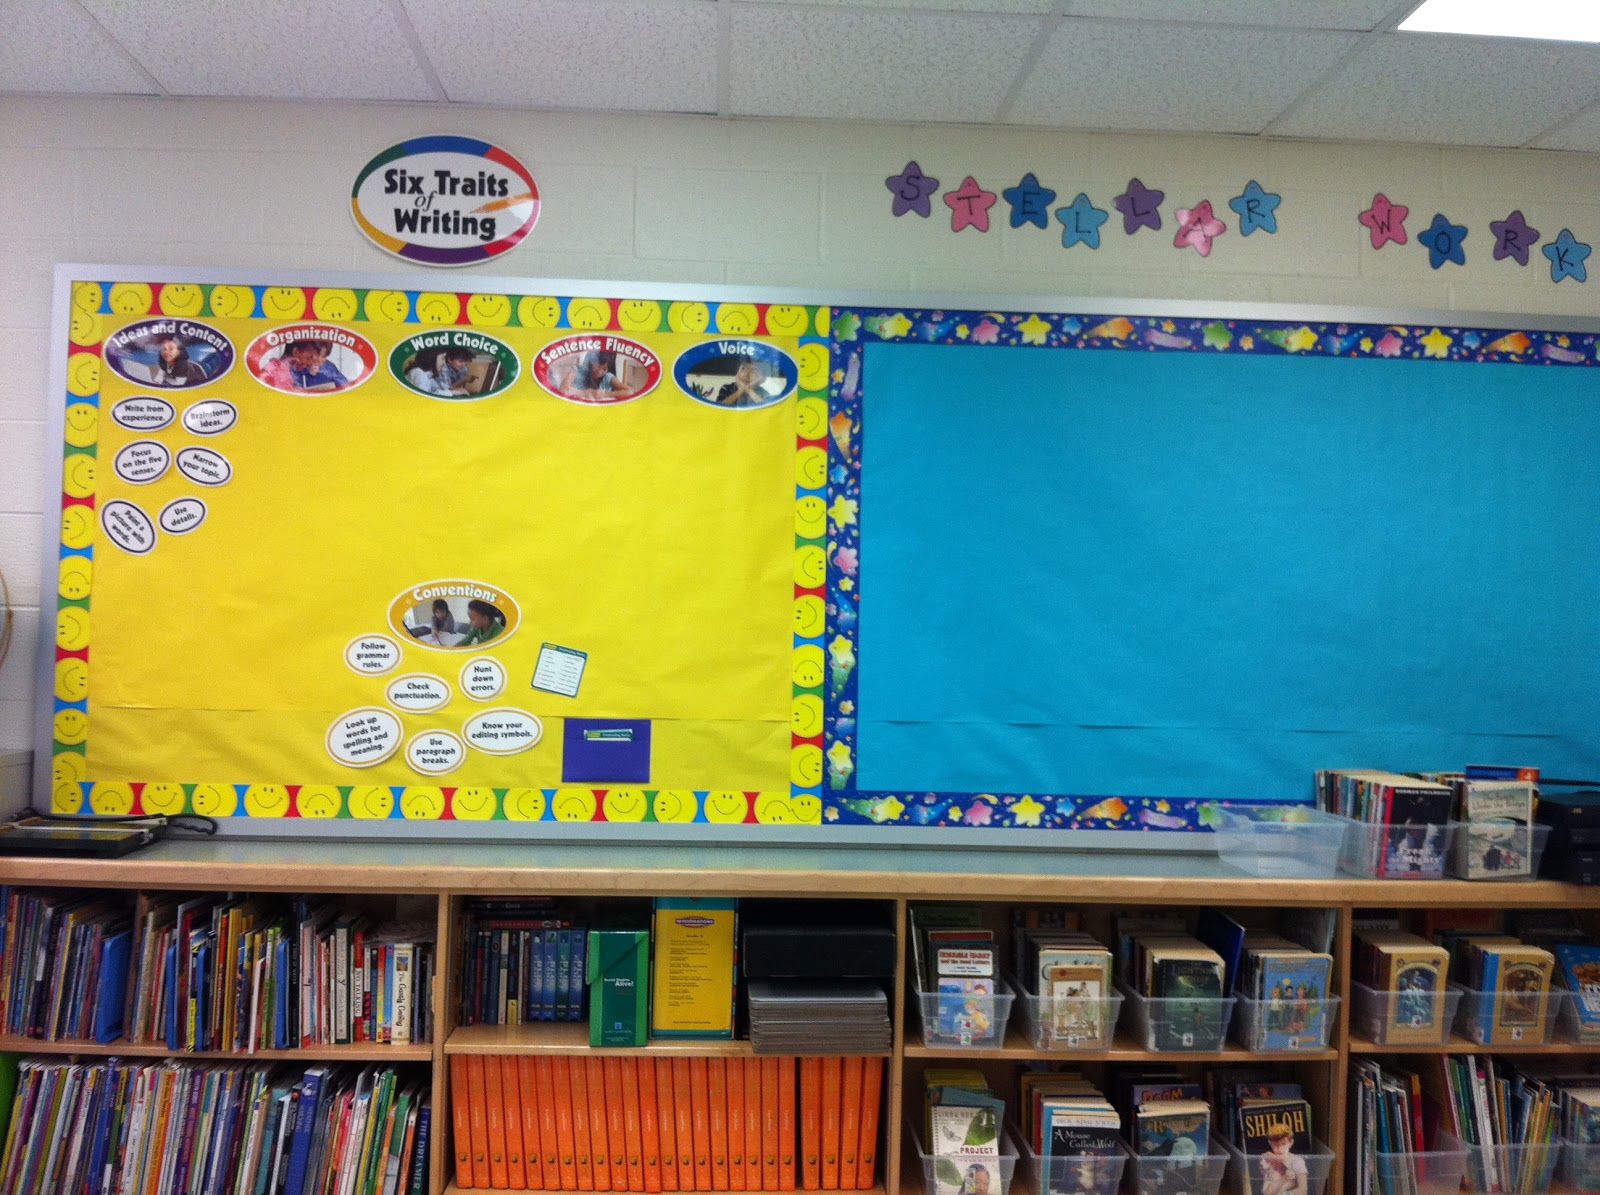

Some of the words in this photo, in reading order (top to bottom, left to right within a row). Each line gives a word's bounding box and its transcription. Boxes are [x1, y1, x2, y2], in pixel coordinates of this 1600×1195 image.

[384, 169, 424, 195] Six
[434, 170, 509, 197] Traits
[414, 190, 437, 212] of
[393, 208, 497, 242] Writing
[113, 327, 149, 348] Ideas
[150, 321, 176, 335] and
[179, 322, 228, 352] Content
[266, 326, 356, 348] Organization
[410, 332, 450, 352] Word
[453, 331, 499, 355] Choice
[540, 339, 602, 365] Sentence
[605, 338, 655, 368] Fluency
[718, 342, 756, 357] Voice
[124, 404, 145, 412] Write
[146, 404, 164, 412] from
[190, 408, 230, 420] Brainstorm
[121, 414, 166, 422] experience.
[200, 419, 223, 428] ideas.
[134, 458, 147, 466] the
[148, 455, 162, 464] five
[192, 453, 219, 468] Narrow
[182, 461, 200, 473] your
[200, 466, 221, 479] topic.
[174, 506, 187, 515] Use
[124, 510, 141, 527] Paint
[171, 513, 198, 526] details.
[110, 510, 133, 532] picture
[131, 530, 145, 545] with
[413, 584, 497, 603] Conventions
[360, 642, 387, 651] Follow
[356, 652, 390, 661] grammar
[362, 660, 384, 669] rules.
[473, 665, 493, 674] Hunt
[472, 674, 494, 682] down
[406, 682, 430, 691] Check
[471, 684, 496, 692] errors.
[394, 691, 442, 701] punctuation.
[345, 719, 365, 730] Look
[366, 716, 378, 726] up
[481, 721, 502, 730] Know
[504, 722, 523, 732] your
[345, 728, 369, 739] words
[370, 725, 381, 734] for
[471, 730, 498, 740] editing
[500, 730, 533, 739] symbols.
[343, 736, 373, 749] spelling
[374, 732, 388, 741] and
[350, 744, 385, 756] meaning.
[415, 747, 456, 757] paragraph
[422, 756, 450, 765] breaks.
[354, 970, 362, 982] NO
[354, 982, 363, 1017] TALKING
[419, 1119, 428, 1138] THE
[1054, 1129, 1066, 1143] A
[1065, 1130, 1090, 1139] Mouse
[1069, 1139, 1095, 1148] Called
[1096, 1137, 1116, 1149] Wolf
[412, 1140, 426, 1190] DREAMER
